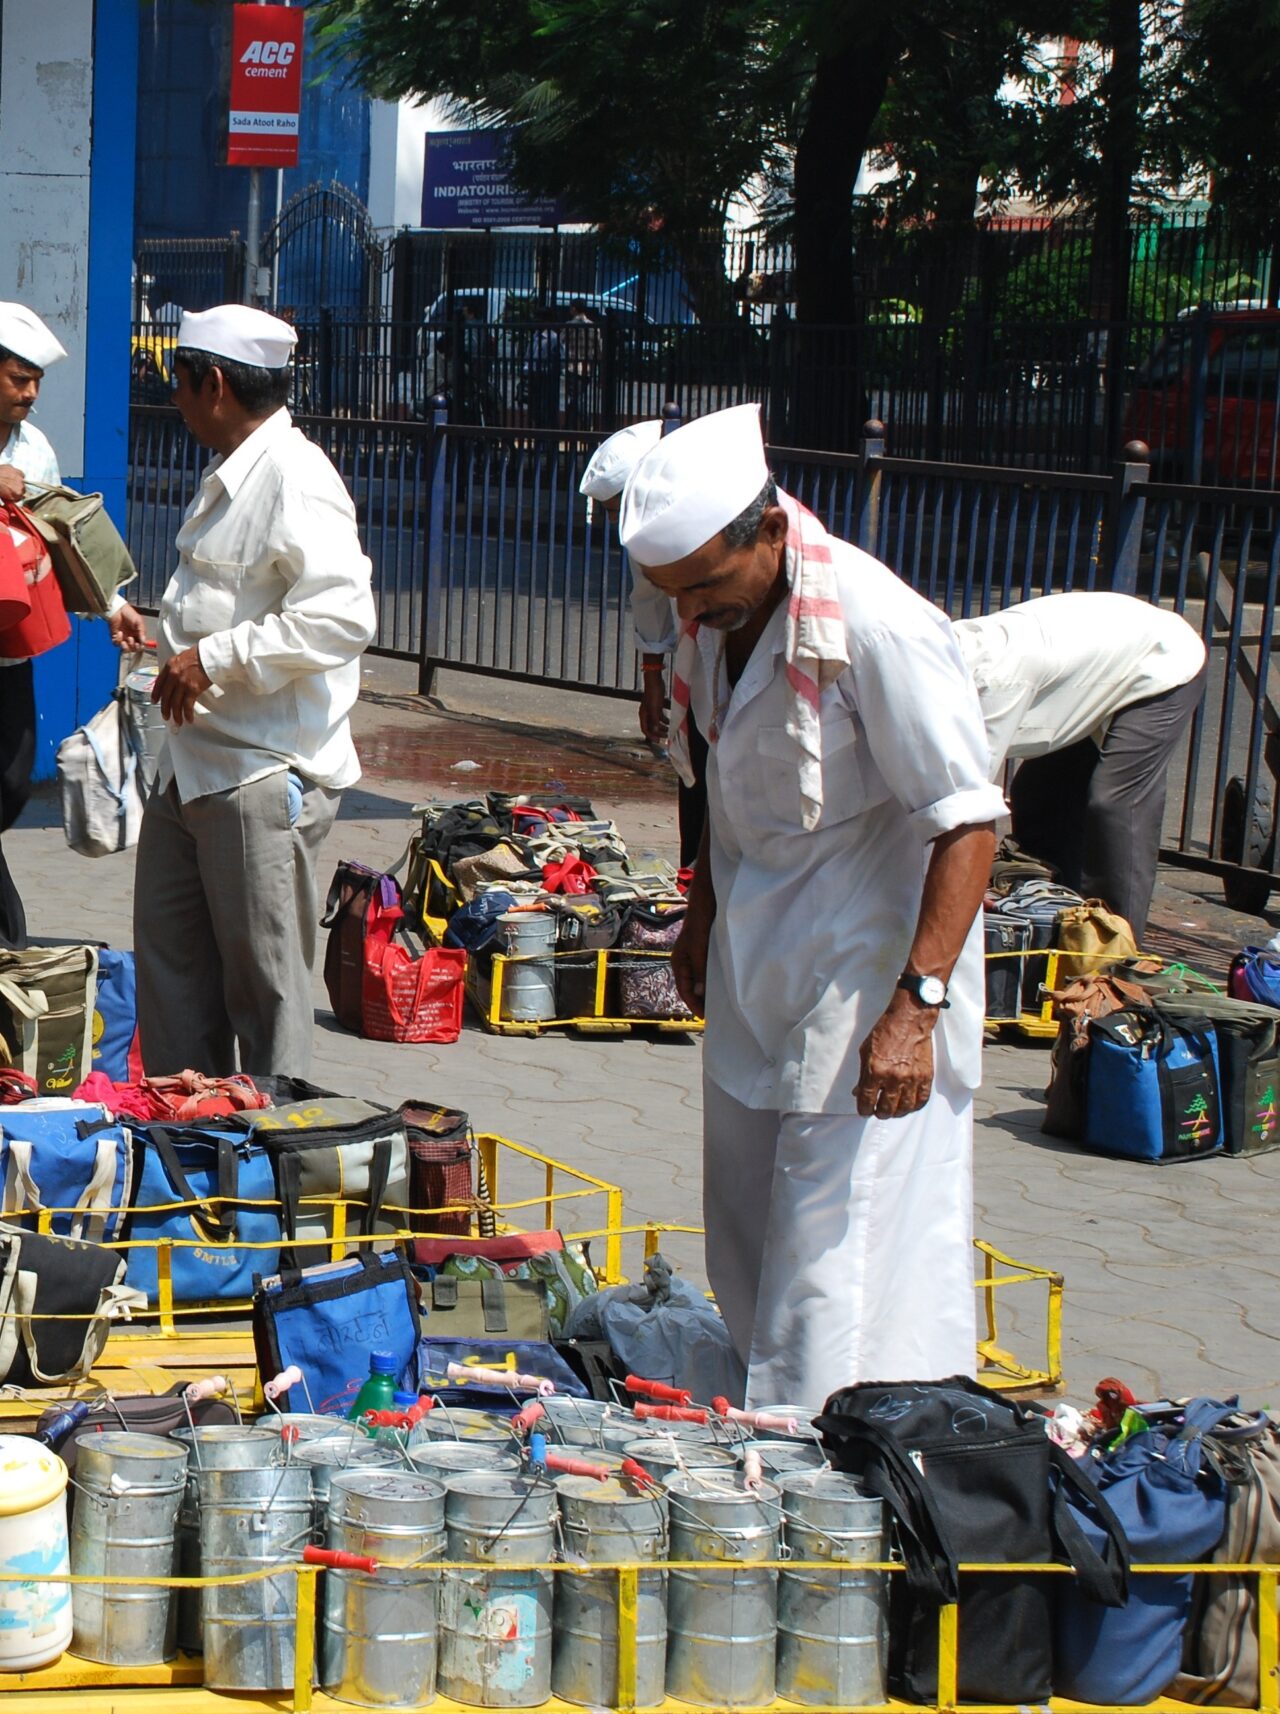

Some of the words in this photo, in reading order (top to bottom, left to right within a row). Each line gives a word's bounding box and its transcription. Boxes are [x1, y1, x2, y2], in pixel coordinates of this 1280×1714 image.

[239, 40, 296, 65] ACC
[244, 65, 287, 78] cement
[232, 116, 252, 127] Sada
[252, 117, 275, 128] Atoot
[276, 118, 296, 128] Raho
